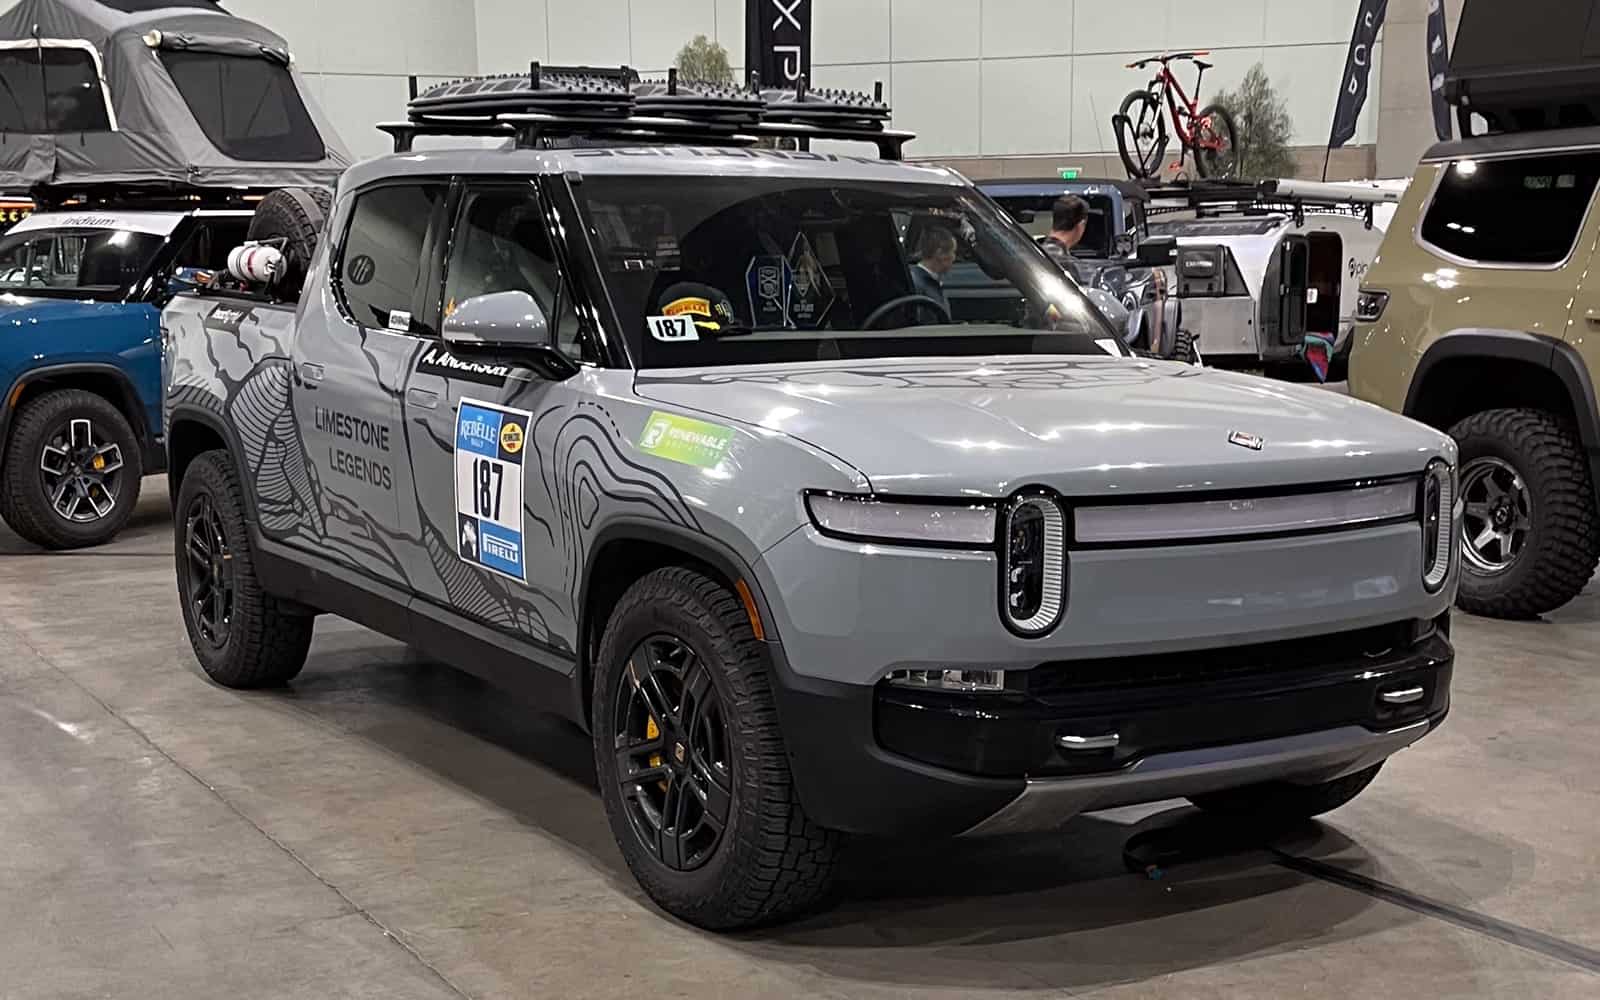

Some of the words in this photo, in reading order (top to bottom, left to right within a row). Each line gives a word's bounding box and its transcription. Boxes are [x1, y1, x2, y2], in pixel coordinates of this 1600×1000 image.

[655, 319, 687, 338] 187
[314, 405, 390, 452] LIMESTONE
[460, 419, 497, 445] REBELLE
[328, 446, 392, 491] LEGENDS
[472, 457, 504, 521] 187
[482, 532, 519, 564] PIRELLI
